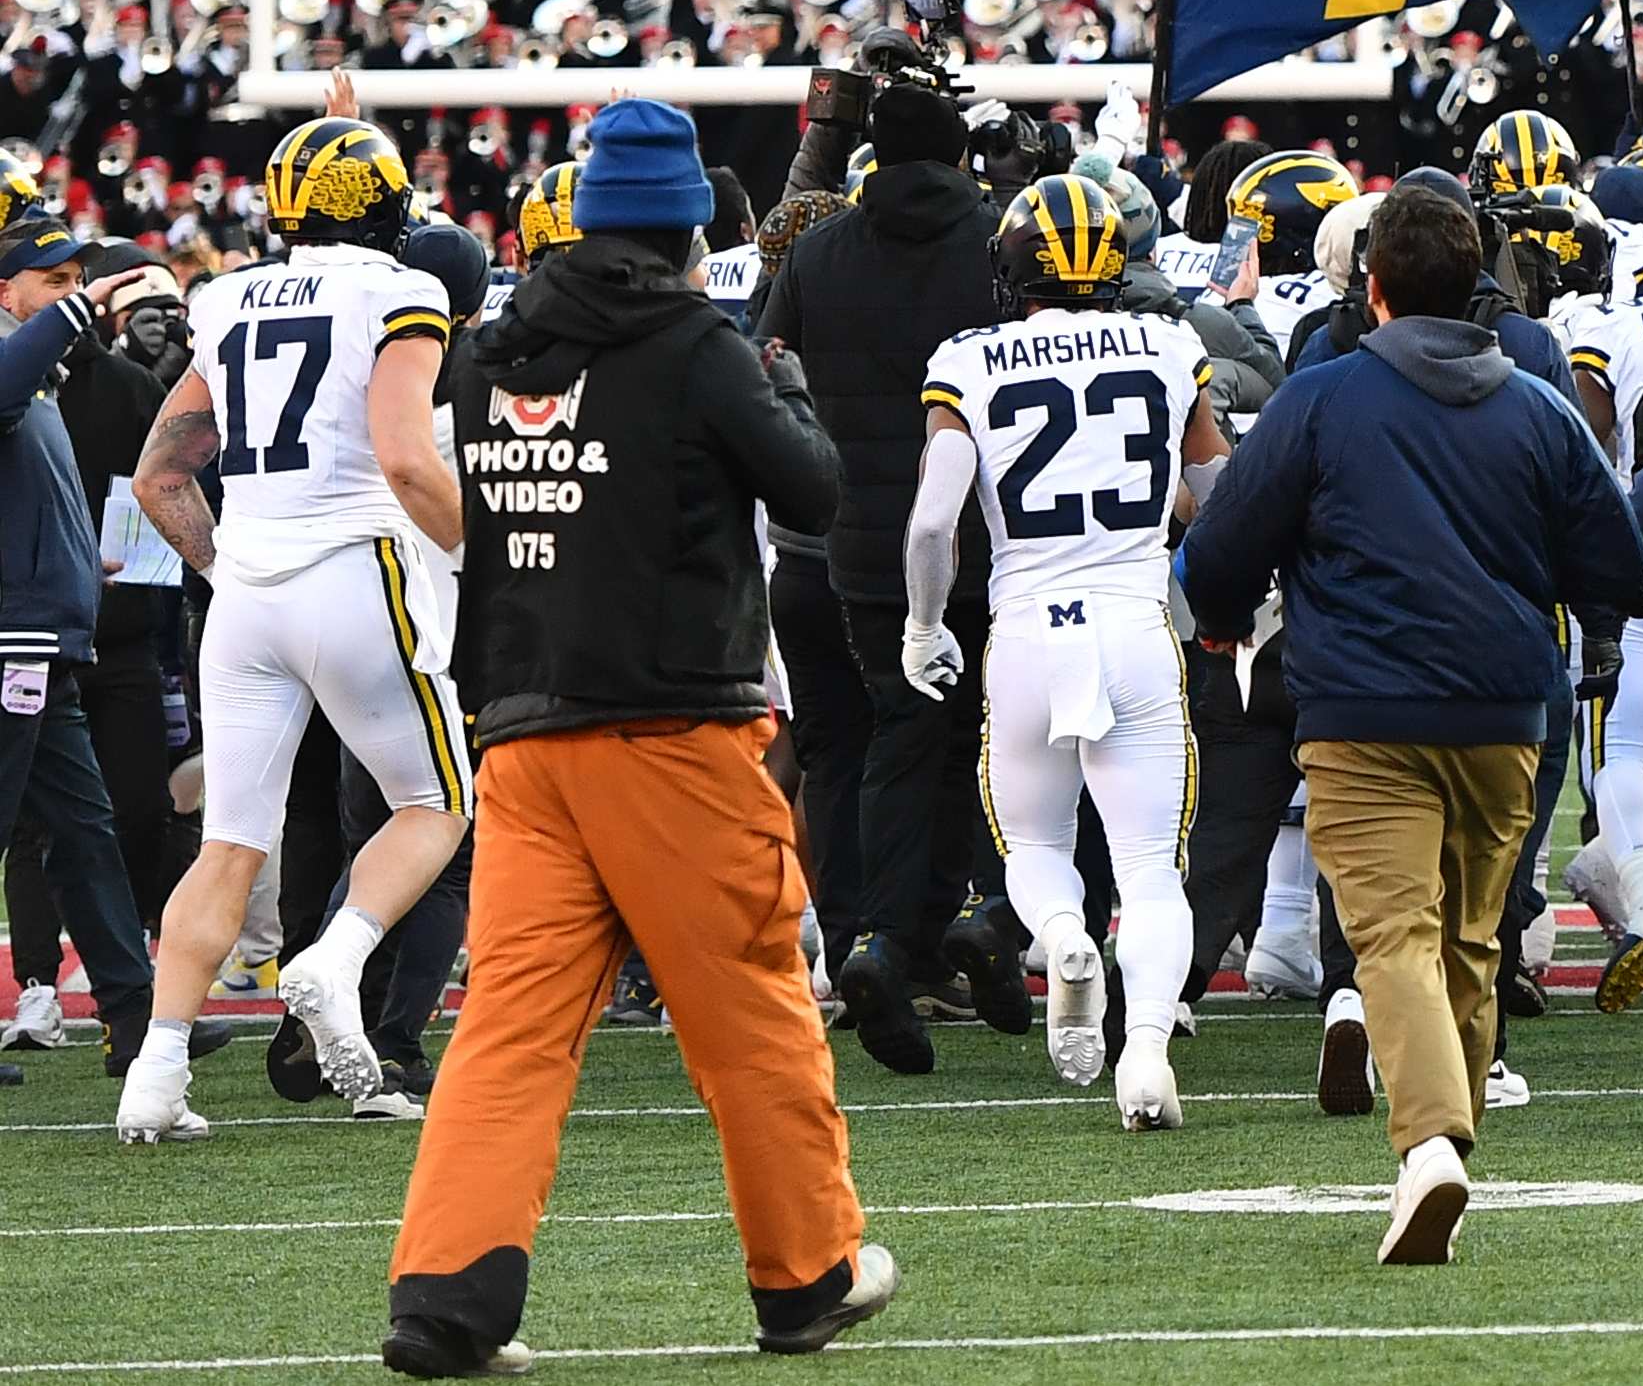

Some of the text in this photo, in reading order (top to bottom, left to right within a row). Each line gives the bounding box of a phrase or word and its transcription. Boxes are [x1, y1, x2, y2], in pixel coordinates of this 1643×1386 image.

[705, 262, 746, 287] RIN
[240, 276, 323, 310] KLEIN
[983, 326, 1160, 375] MARSHALL
[218, 315, 333, 477] 17
[464, 440, 609, 474] PHOTO &
[988, 370, 1170, 540] 23
[479, 480, 583, 513] VIDEO
[507, 531, 556, 569] 075
[1048, 600, 1086, 627] M
